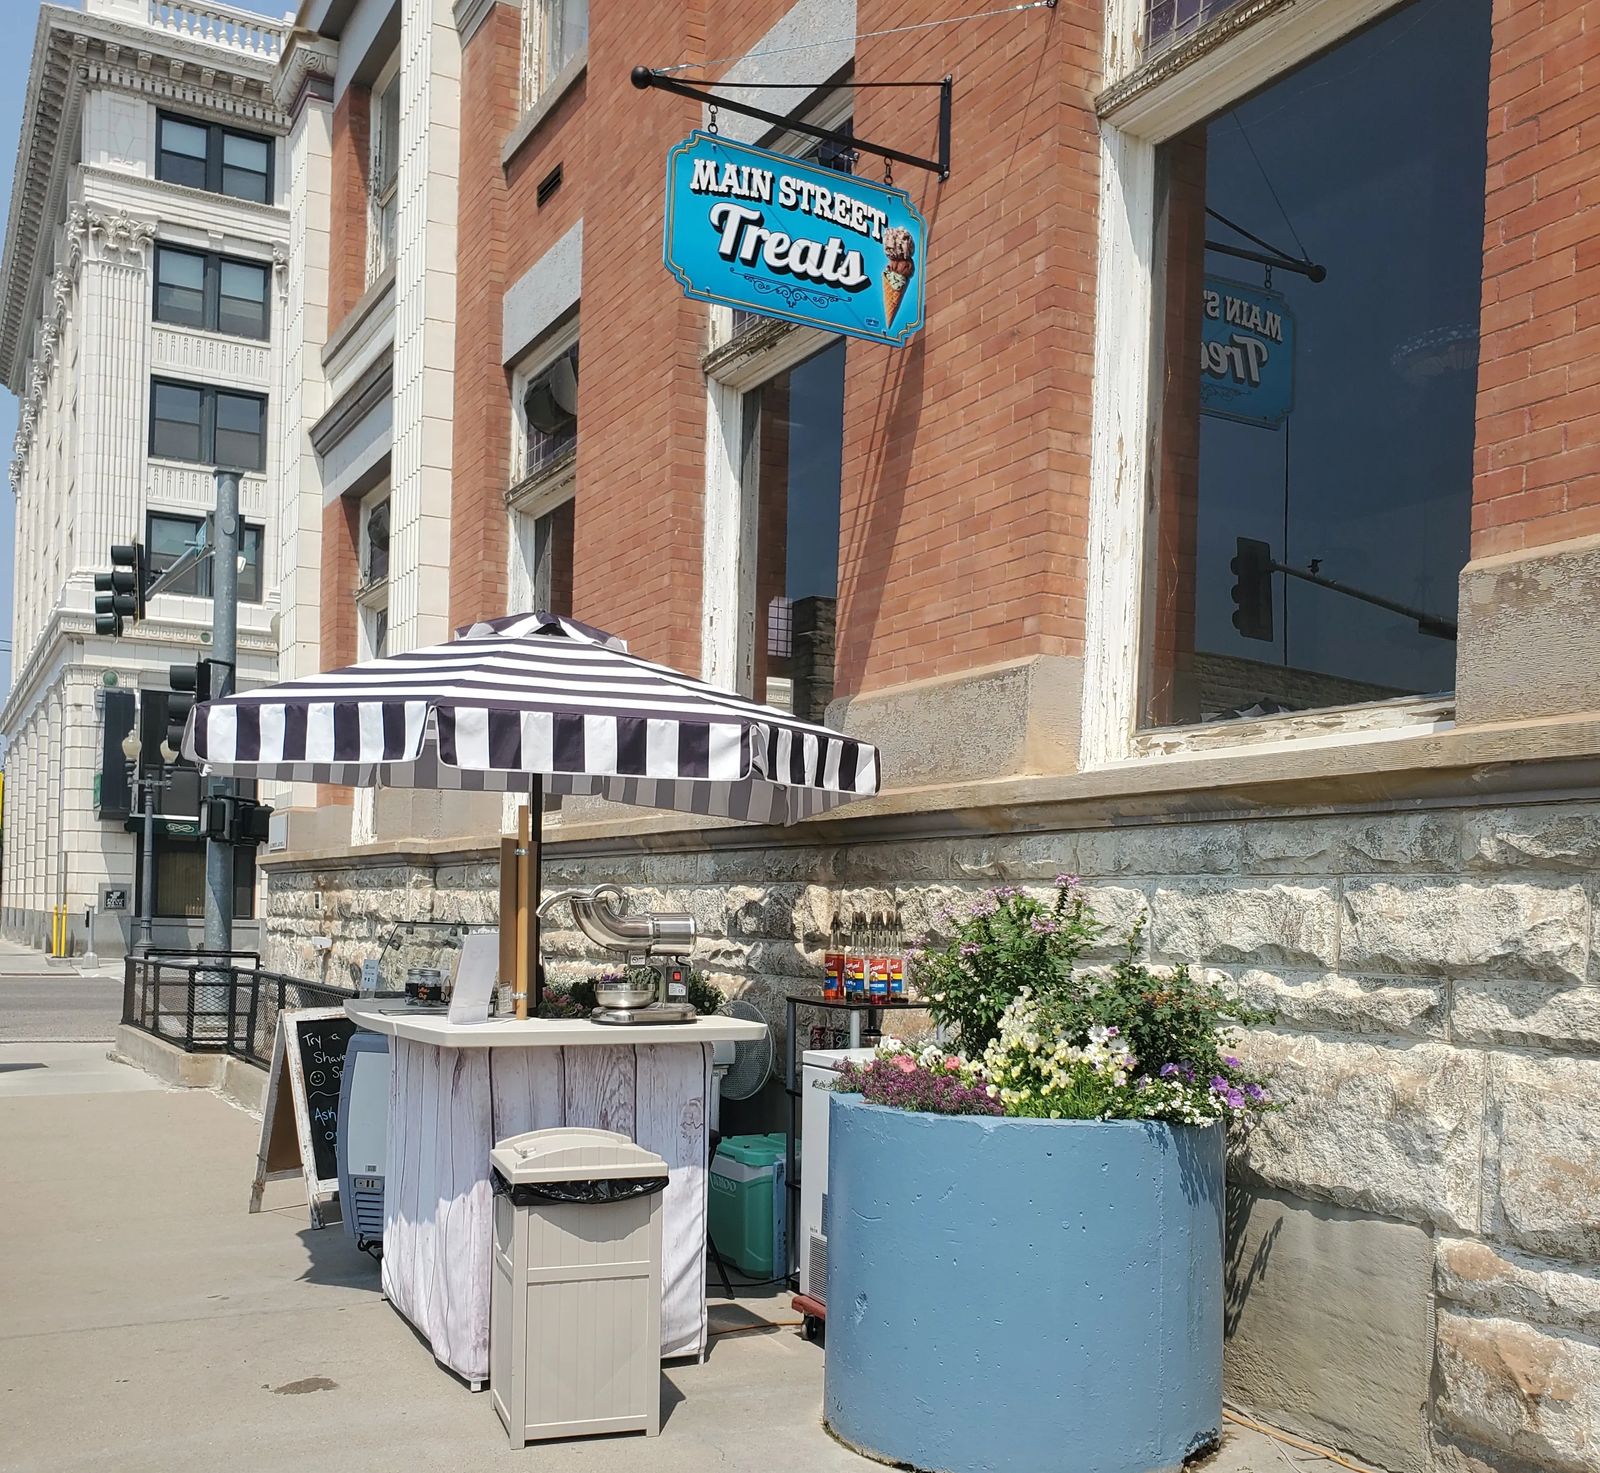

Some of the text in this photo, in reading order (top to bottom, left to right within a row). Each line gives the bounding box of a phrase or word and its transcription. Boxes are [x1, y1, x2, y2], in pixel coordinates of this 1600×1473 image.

[690, 158, 887, 240] MAIN STREET
[709, 202, 869, 287] Treats
[302, 1032, 341, 1049] Try a
